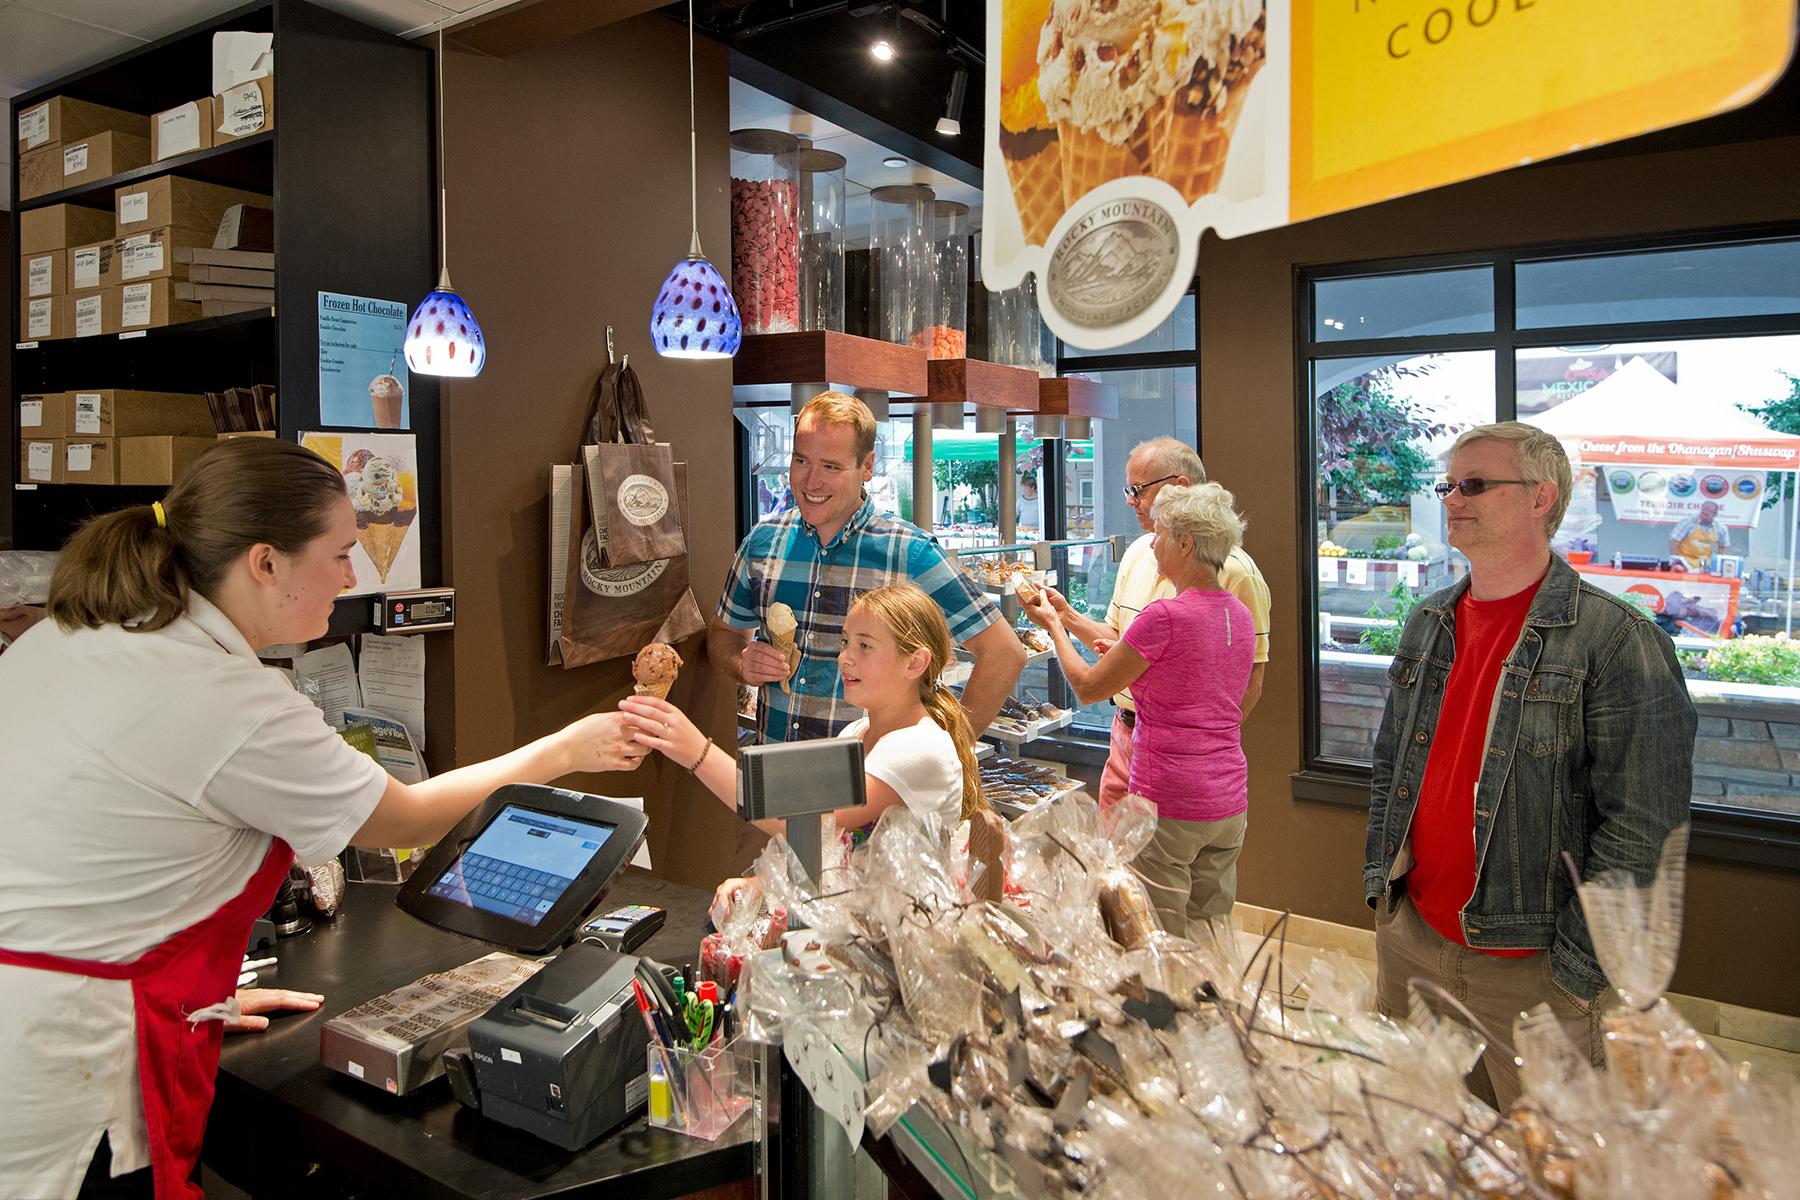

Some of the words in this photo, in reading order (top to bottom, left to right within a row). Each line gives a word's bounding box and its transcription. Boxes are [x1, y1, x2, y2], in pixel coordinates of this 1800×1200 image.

[1055, 214, 1097, 261] ROCKY
[1100, 202, 1172, 236] MOUNTAIN
[323, 294, 350, 310] Frozen
[352, 298, 366, 313] Hot
[368, 301, 404, 317] Chocolate
[1580, 440, 1616, 453] Cheese
[1615, 441, 1646, 456] from
[1647, 442, 1666, 454] the
[582, 570, 610, 593] ROCKY
[614, 561, 664, 594] MOUNTAIN
[475, 1052, 493, 1064] EPSON
